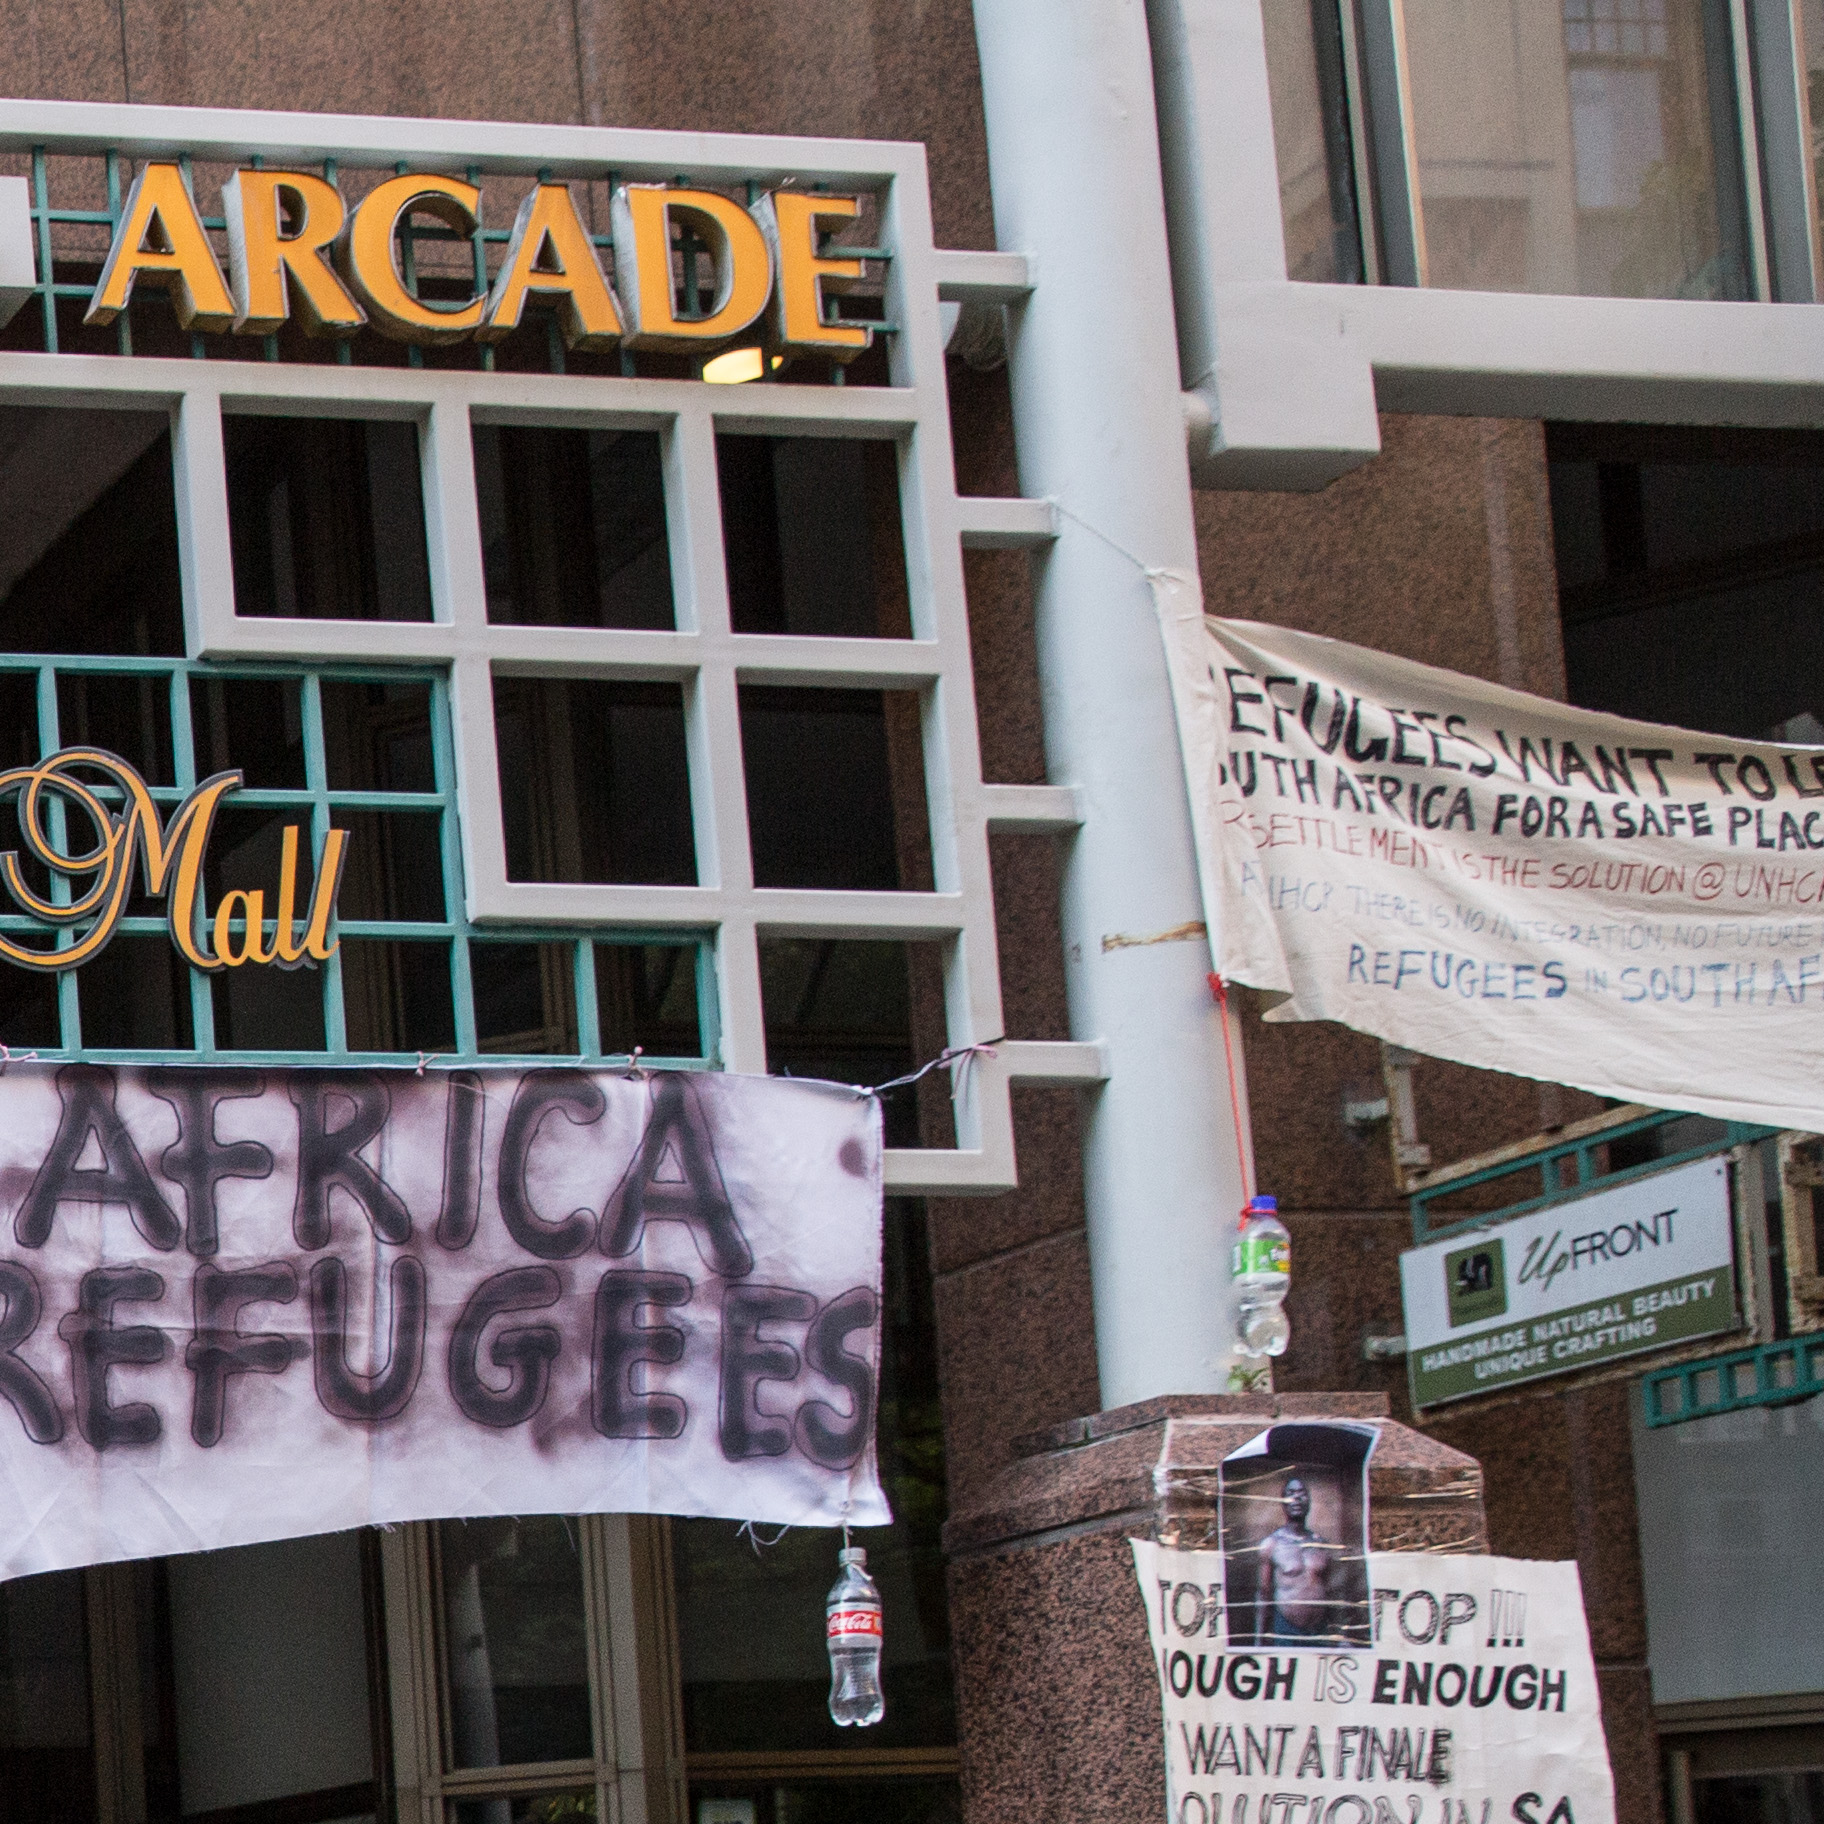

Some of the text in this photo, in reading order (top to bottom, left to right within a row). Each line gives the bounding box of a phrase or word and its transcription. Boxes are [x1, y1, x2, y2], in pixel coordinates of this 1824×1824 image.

[86, 162, 874, 365] ARCADE
[1494, 729, 1777, 801] WANT TO
[1333, 765, 1477, 834] AFRICA
[1492, 793, 1571, 839] FOR
[1577, 800, 1605, 839] A
[1612, 801, 1714, 840] SAFE
[1549, 861, 1686, 895] SOLUTION
[1692, 861, 1726, 901] @
[1347, 945, 1568, 1000] REFUGEES
[1620, 960, 1757, 1007] SOUTH
[14, 1065, 754, 1278] AFRICA
[1421, 1277, 1718, 1374] HANDMADE NATURAL BEAUTY
[1473, 1317, 1658, 1381] UNIQUE CRAFTING
[1313, 1655, 1568, 1713] IS ENOUGH
[1180, 1722, 1295, 1777] WANT
[1295, 1725, 1325, 1780] A
